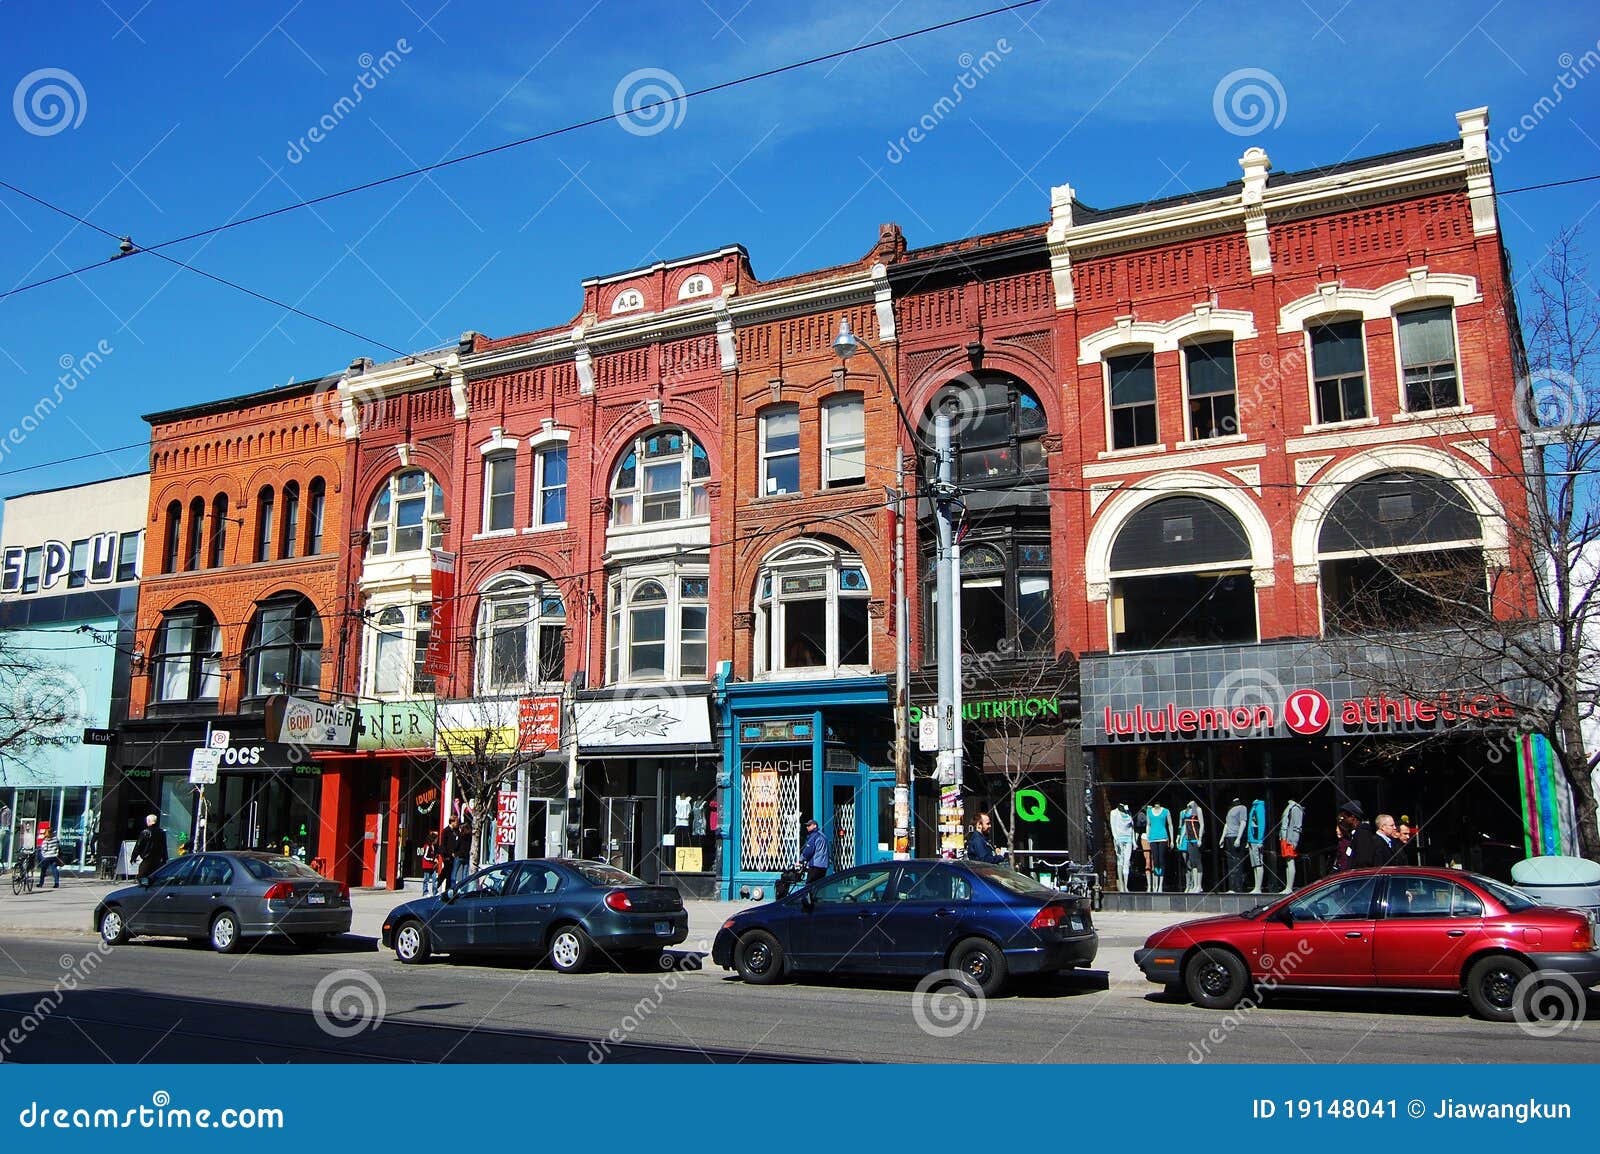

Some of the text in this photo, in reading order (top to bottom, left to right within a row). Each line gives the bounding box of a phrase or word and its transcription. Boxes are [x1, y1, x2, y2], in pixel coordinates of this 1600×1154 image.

[316, 707, 353, 727] DINER
[1104, 703, 1274, 735] lululemon
[91, 732, 111, 741] fcuk
[217, 746, 260, 765] rocs
[741, 760, 812, 773] FRAICHE
[500, 796, 517, 811] $10
[500, 812, 516, 827] $20
[498, 828, 516, 843] $30
